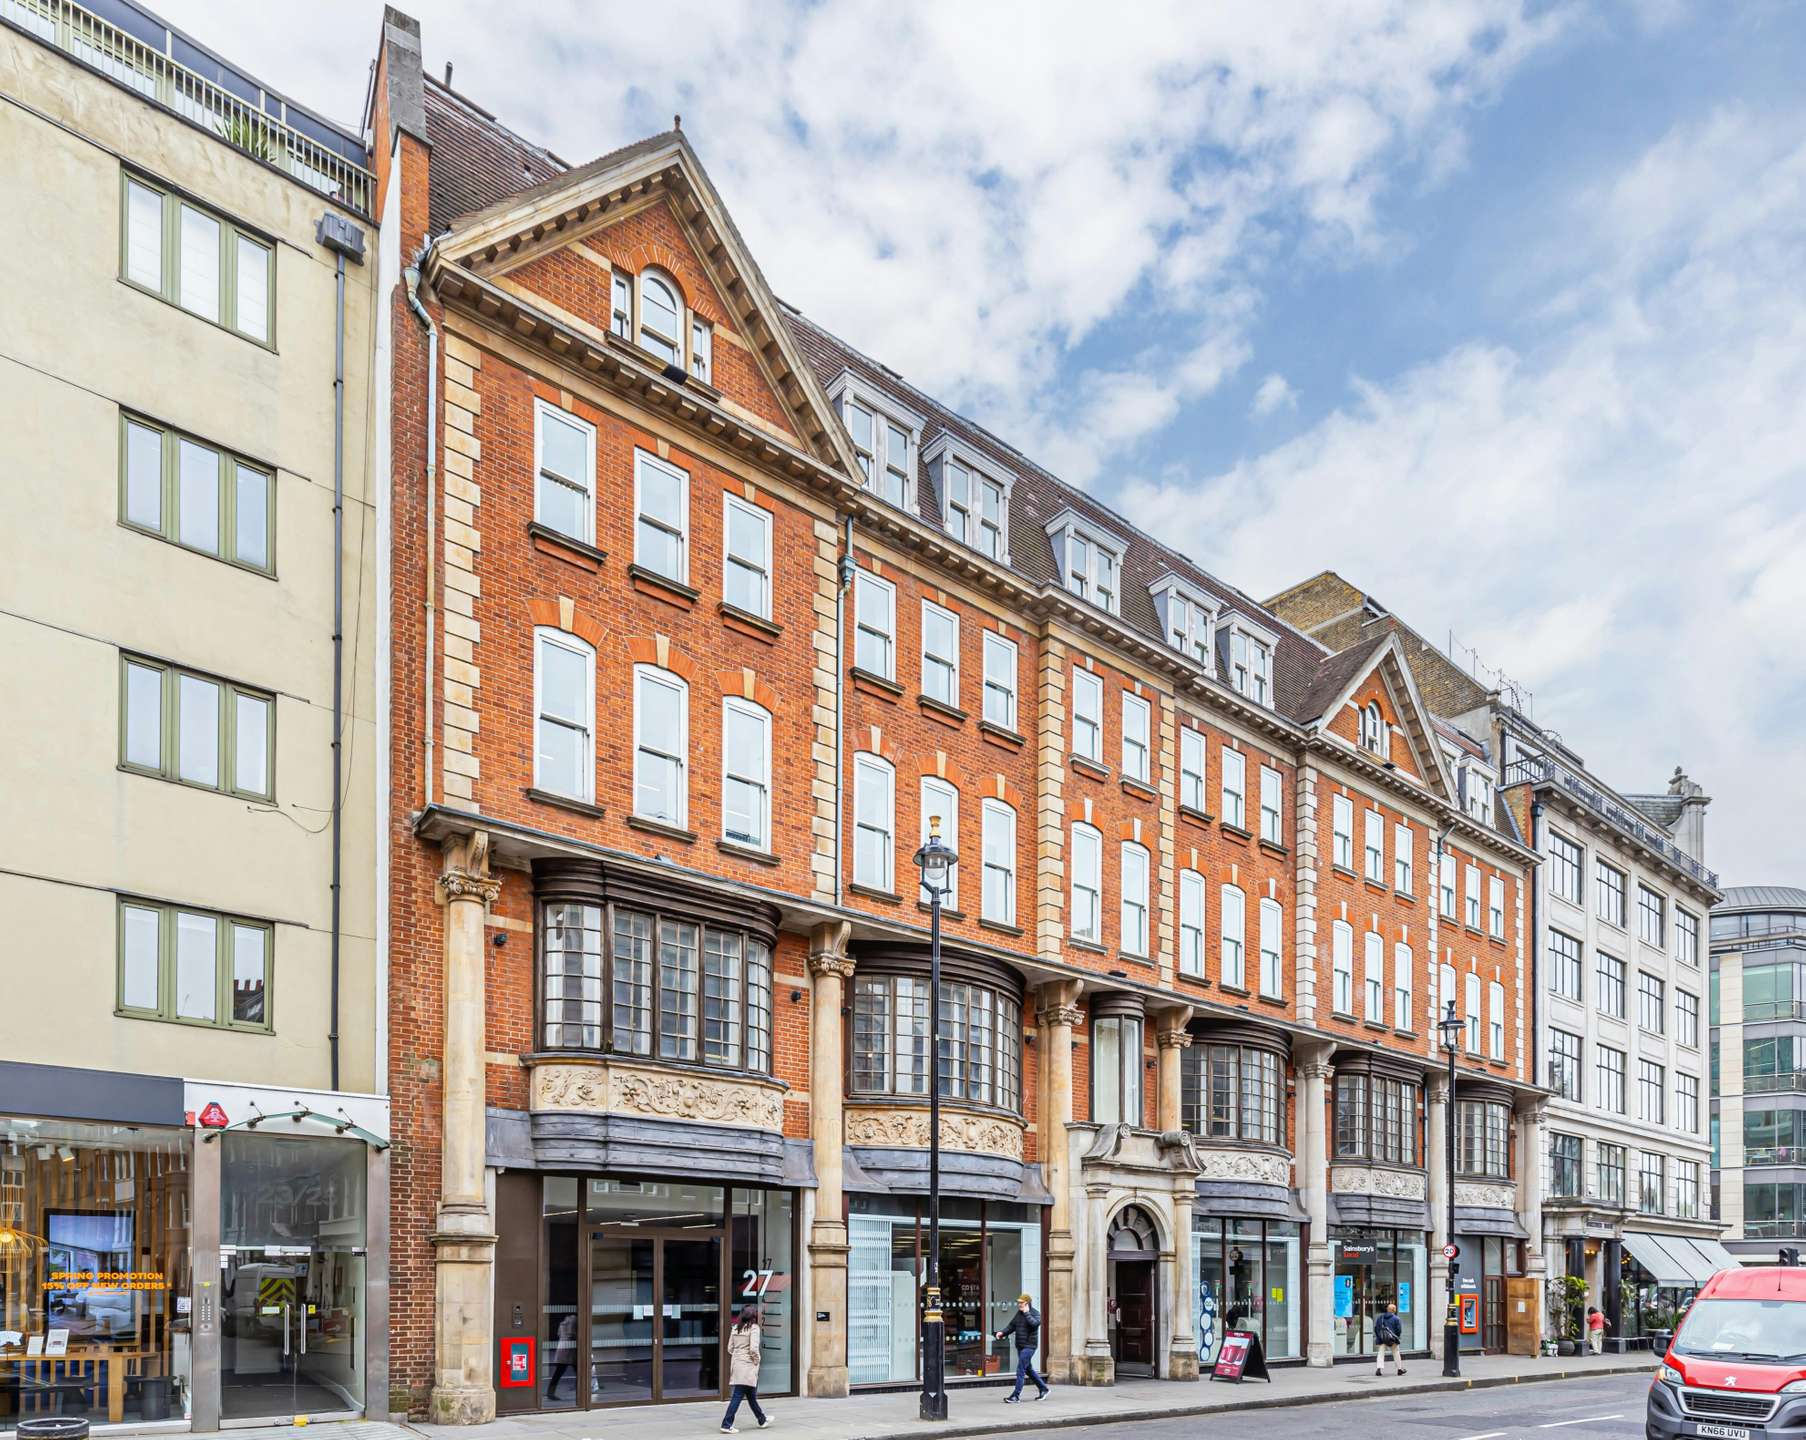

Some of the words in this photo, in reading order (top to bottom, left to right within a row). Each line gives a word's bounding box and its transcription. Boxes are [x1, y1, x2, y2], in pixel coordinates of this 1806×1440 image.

[1343, 1245, 1375, 1254] Sainsbury's
[51, 1272, 95, 1280] SPRING
[97, 1272, 164, 1280] PROMOTION
[41, 1282, 65, 1290] 15%
[67, 1282, 89, 1290] OFF
[92, 1282, 118, 1290] NEW
[121, 1282, 165, 1290] ORDERS
[742, 1269, 774, 1297] 27
[1701, 1425, 1725, 1436] KN66
[1727, 1428, 1746, 1438] UVU
